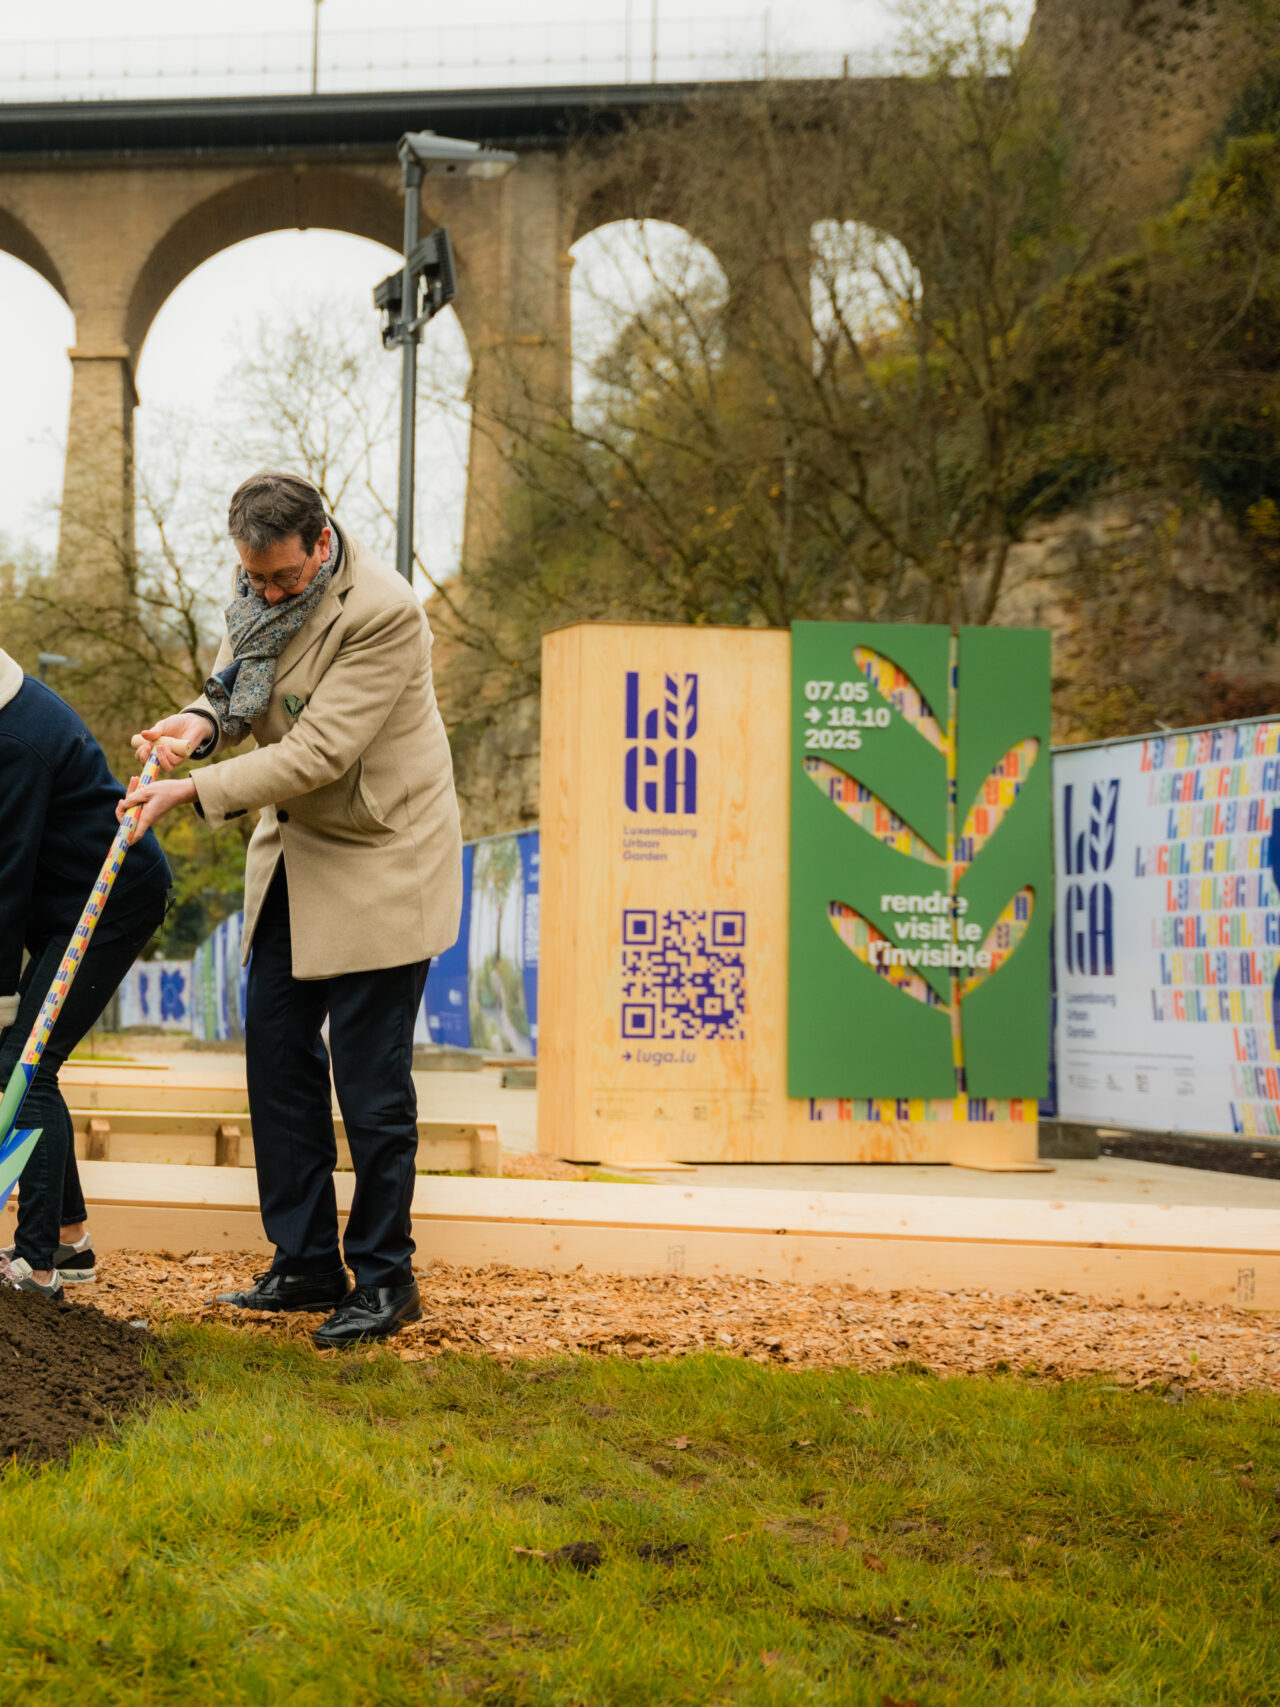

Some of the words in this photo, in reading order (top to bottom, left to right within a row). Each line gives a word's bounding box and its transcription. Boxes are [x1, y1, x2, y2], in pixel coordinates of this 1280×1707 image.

[805, 681, 869, 702] 07.05
[827, 706, 891, 728] 18.10
[805, 729, 862, 750] 2025
[623, 825, 697, 839] Luxembourg
[623, 838, 660, 849] Urban
[623, 850, 668, 861] Garden
[881, 890, 969, 914] rendre
[636, 1048, 696, 1067] luga.lu
